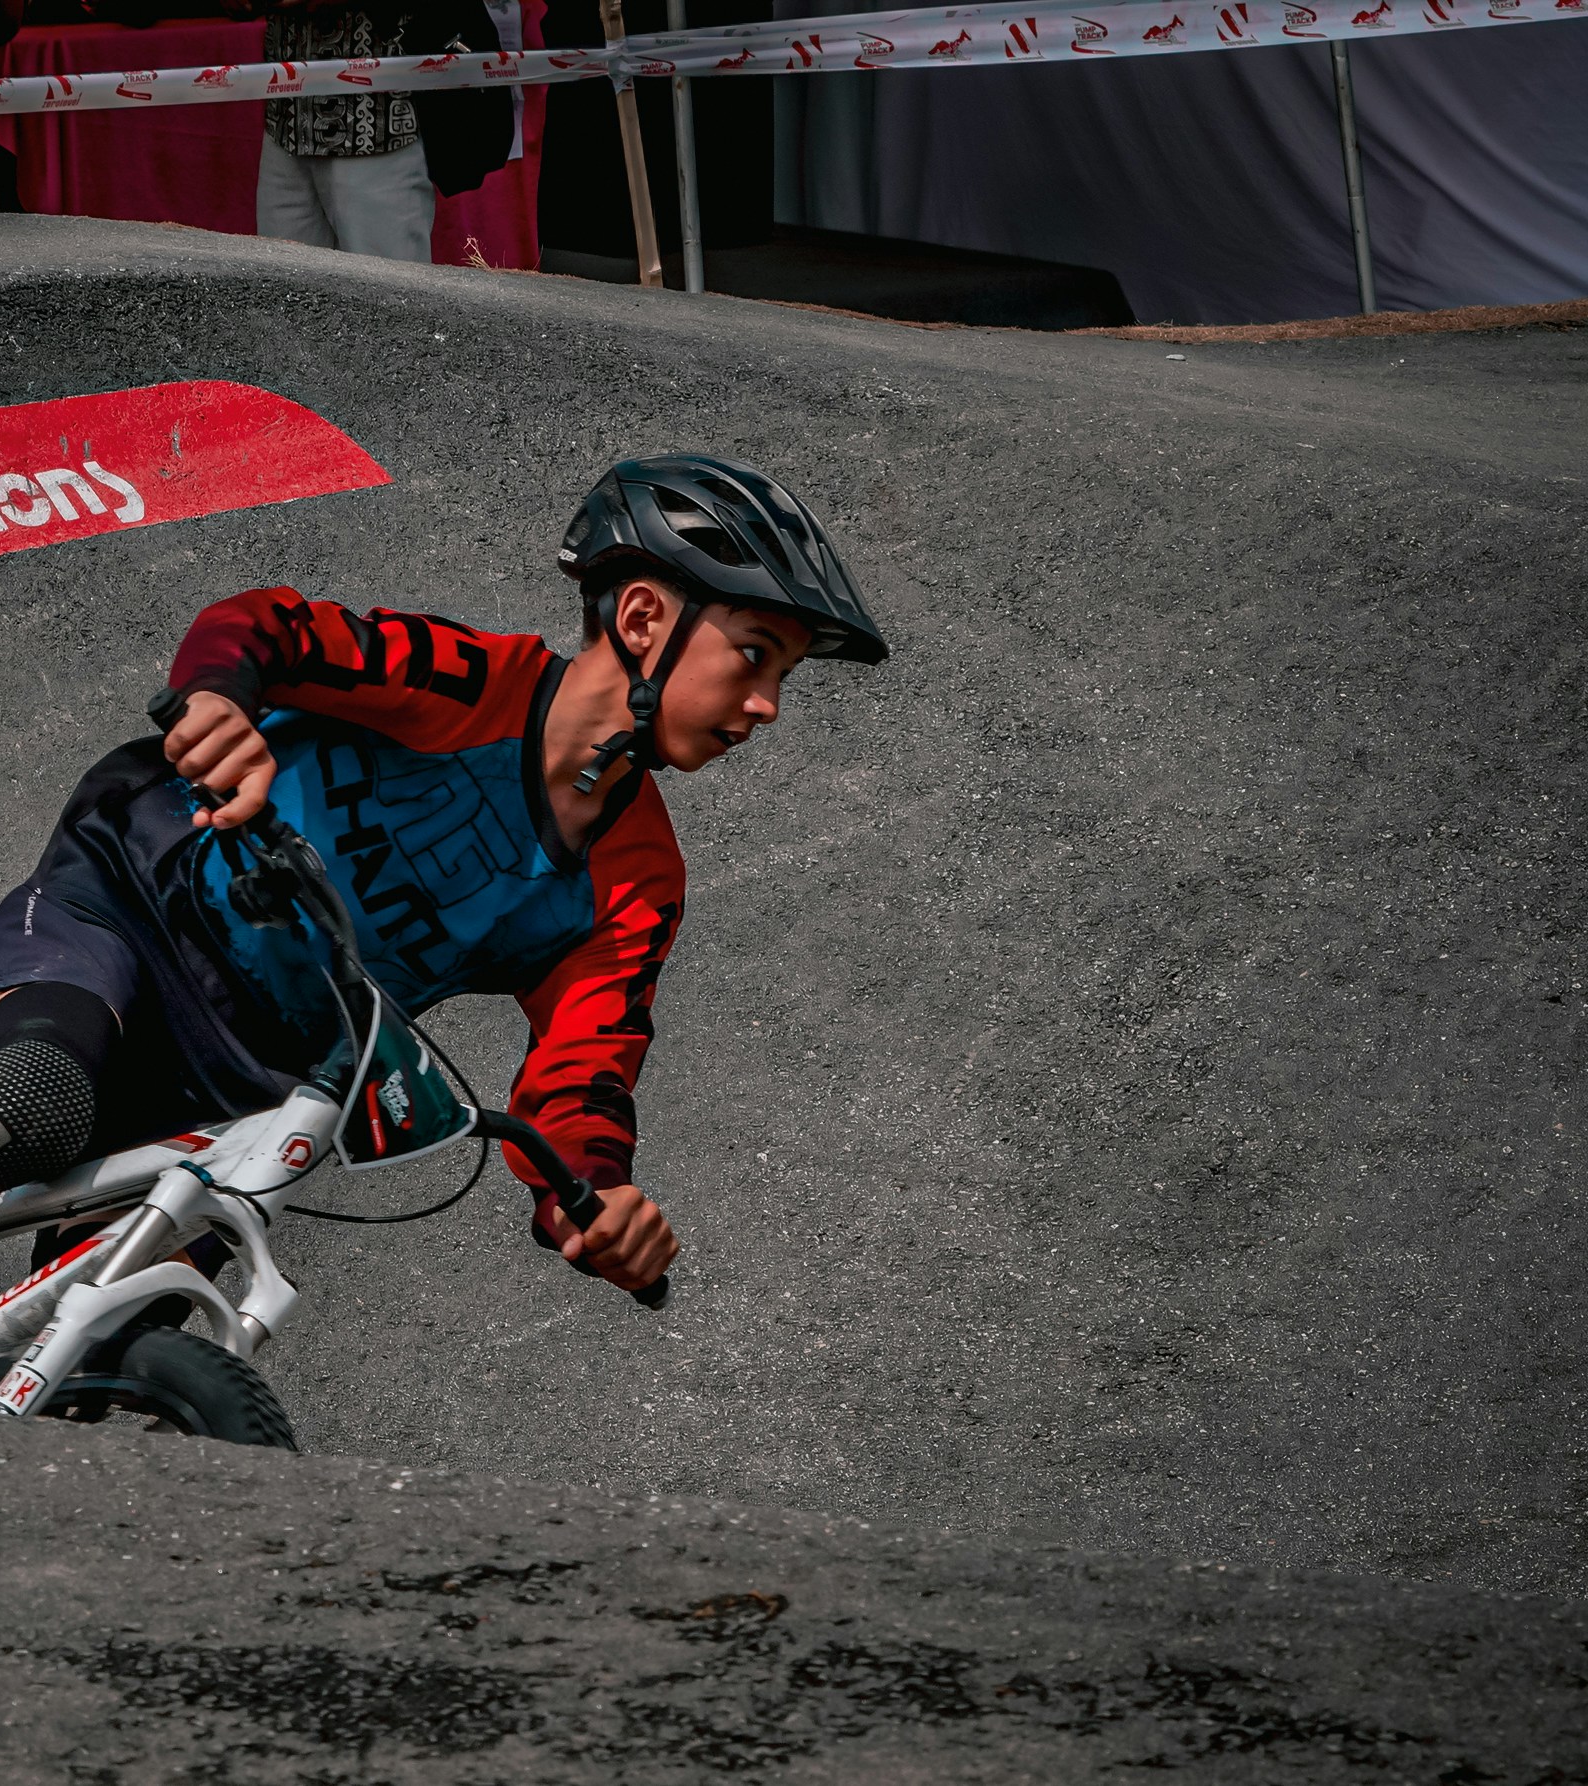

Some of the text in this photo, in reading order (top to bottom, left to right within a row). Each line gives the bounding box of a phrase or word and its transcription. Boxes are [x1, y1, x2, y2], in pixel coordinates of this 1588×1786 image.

[1285, 11, 1306, 19] PUMP
[1286, 17, 1311, 25] TRACK
[1075, 26, 1096, 35] PUMP
[1077, 32, 1102, 40] TRACK
[862, 41, 882, 49] PUMP
[863, 47, 888, 55] TRACK
[348, 62, 374, 70] TRACK
[125, 74, 152, 82] TRACK
[267, 77, 305, 93] zerolevel
